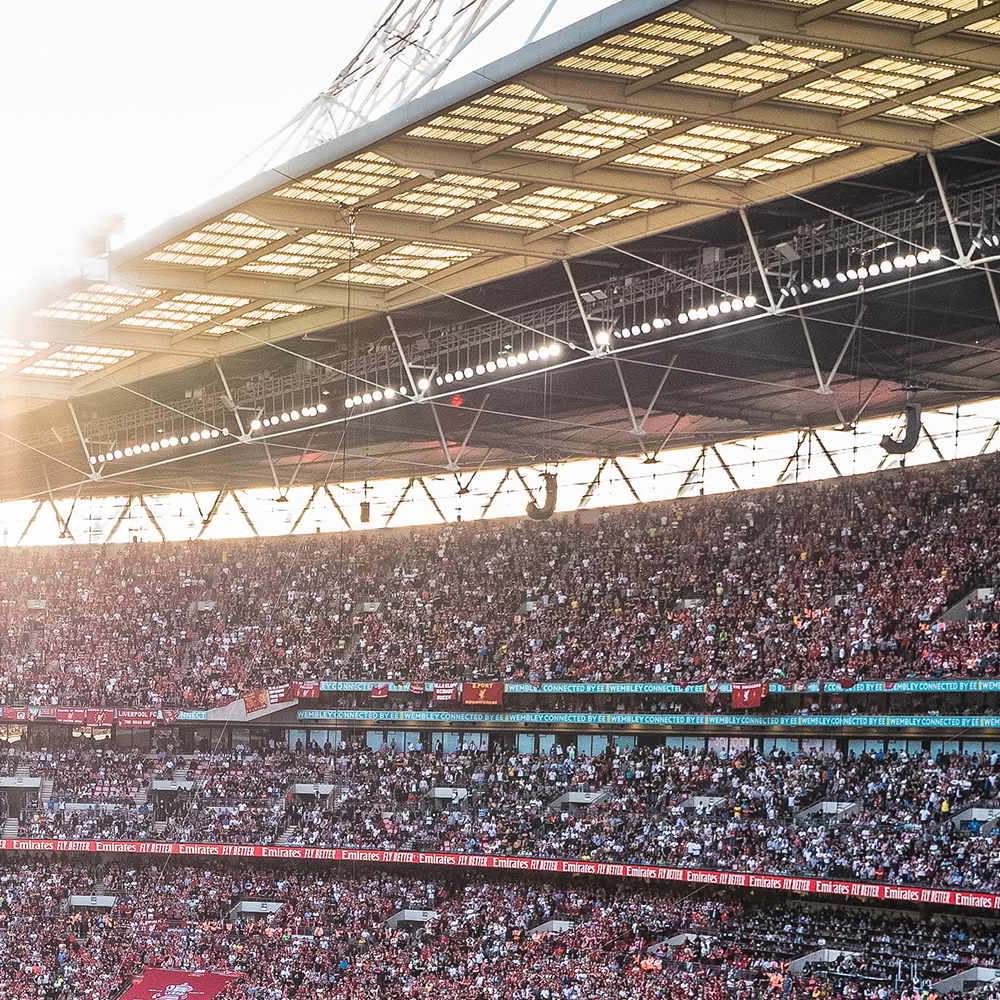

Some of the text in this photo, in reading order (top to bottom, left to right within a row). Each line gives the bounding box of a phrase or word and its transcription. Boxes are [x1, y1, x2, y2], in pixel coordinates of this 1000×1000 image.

[13, 840, 90, 851] Emirates FLY BETTER
[96, 842, 172, 853] Emirates FLY BETTER
[179, 844, 254, 856] Emirates FLY BETTER
[262, 847, 335, 858] Emirates FLY BETTER
[342, 850, 412, 862] Emirates FLY BETTER
[419, 853, 488, 866] Emirates FLY BETTER
[493, 857, 558, 871] Emirates FLY BETTER
[563, 861, 595, 873] Emirates
[606, 864, 623, 875] BETTER
[627, 866, 656, 878] Emirates
[666, 868, 683, 880] BETTER
[687, 870, 717, 883] Emirates
[728, 874, 745, 885] BETTER
[750, 876, 781, 889] Emirates
[792, 879, 810, 891] BETTER
[851, 884, 878, 897] FLY BETTER
[885, 887, 950, 904] Emirates FLY BETTER
[956, 893, 992, 907] Emirates
